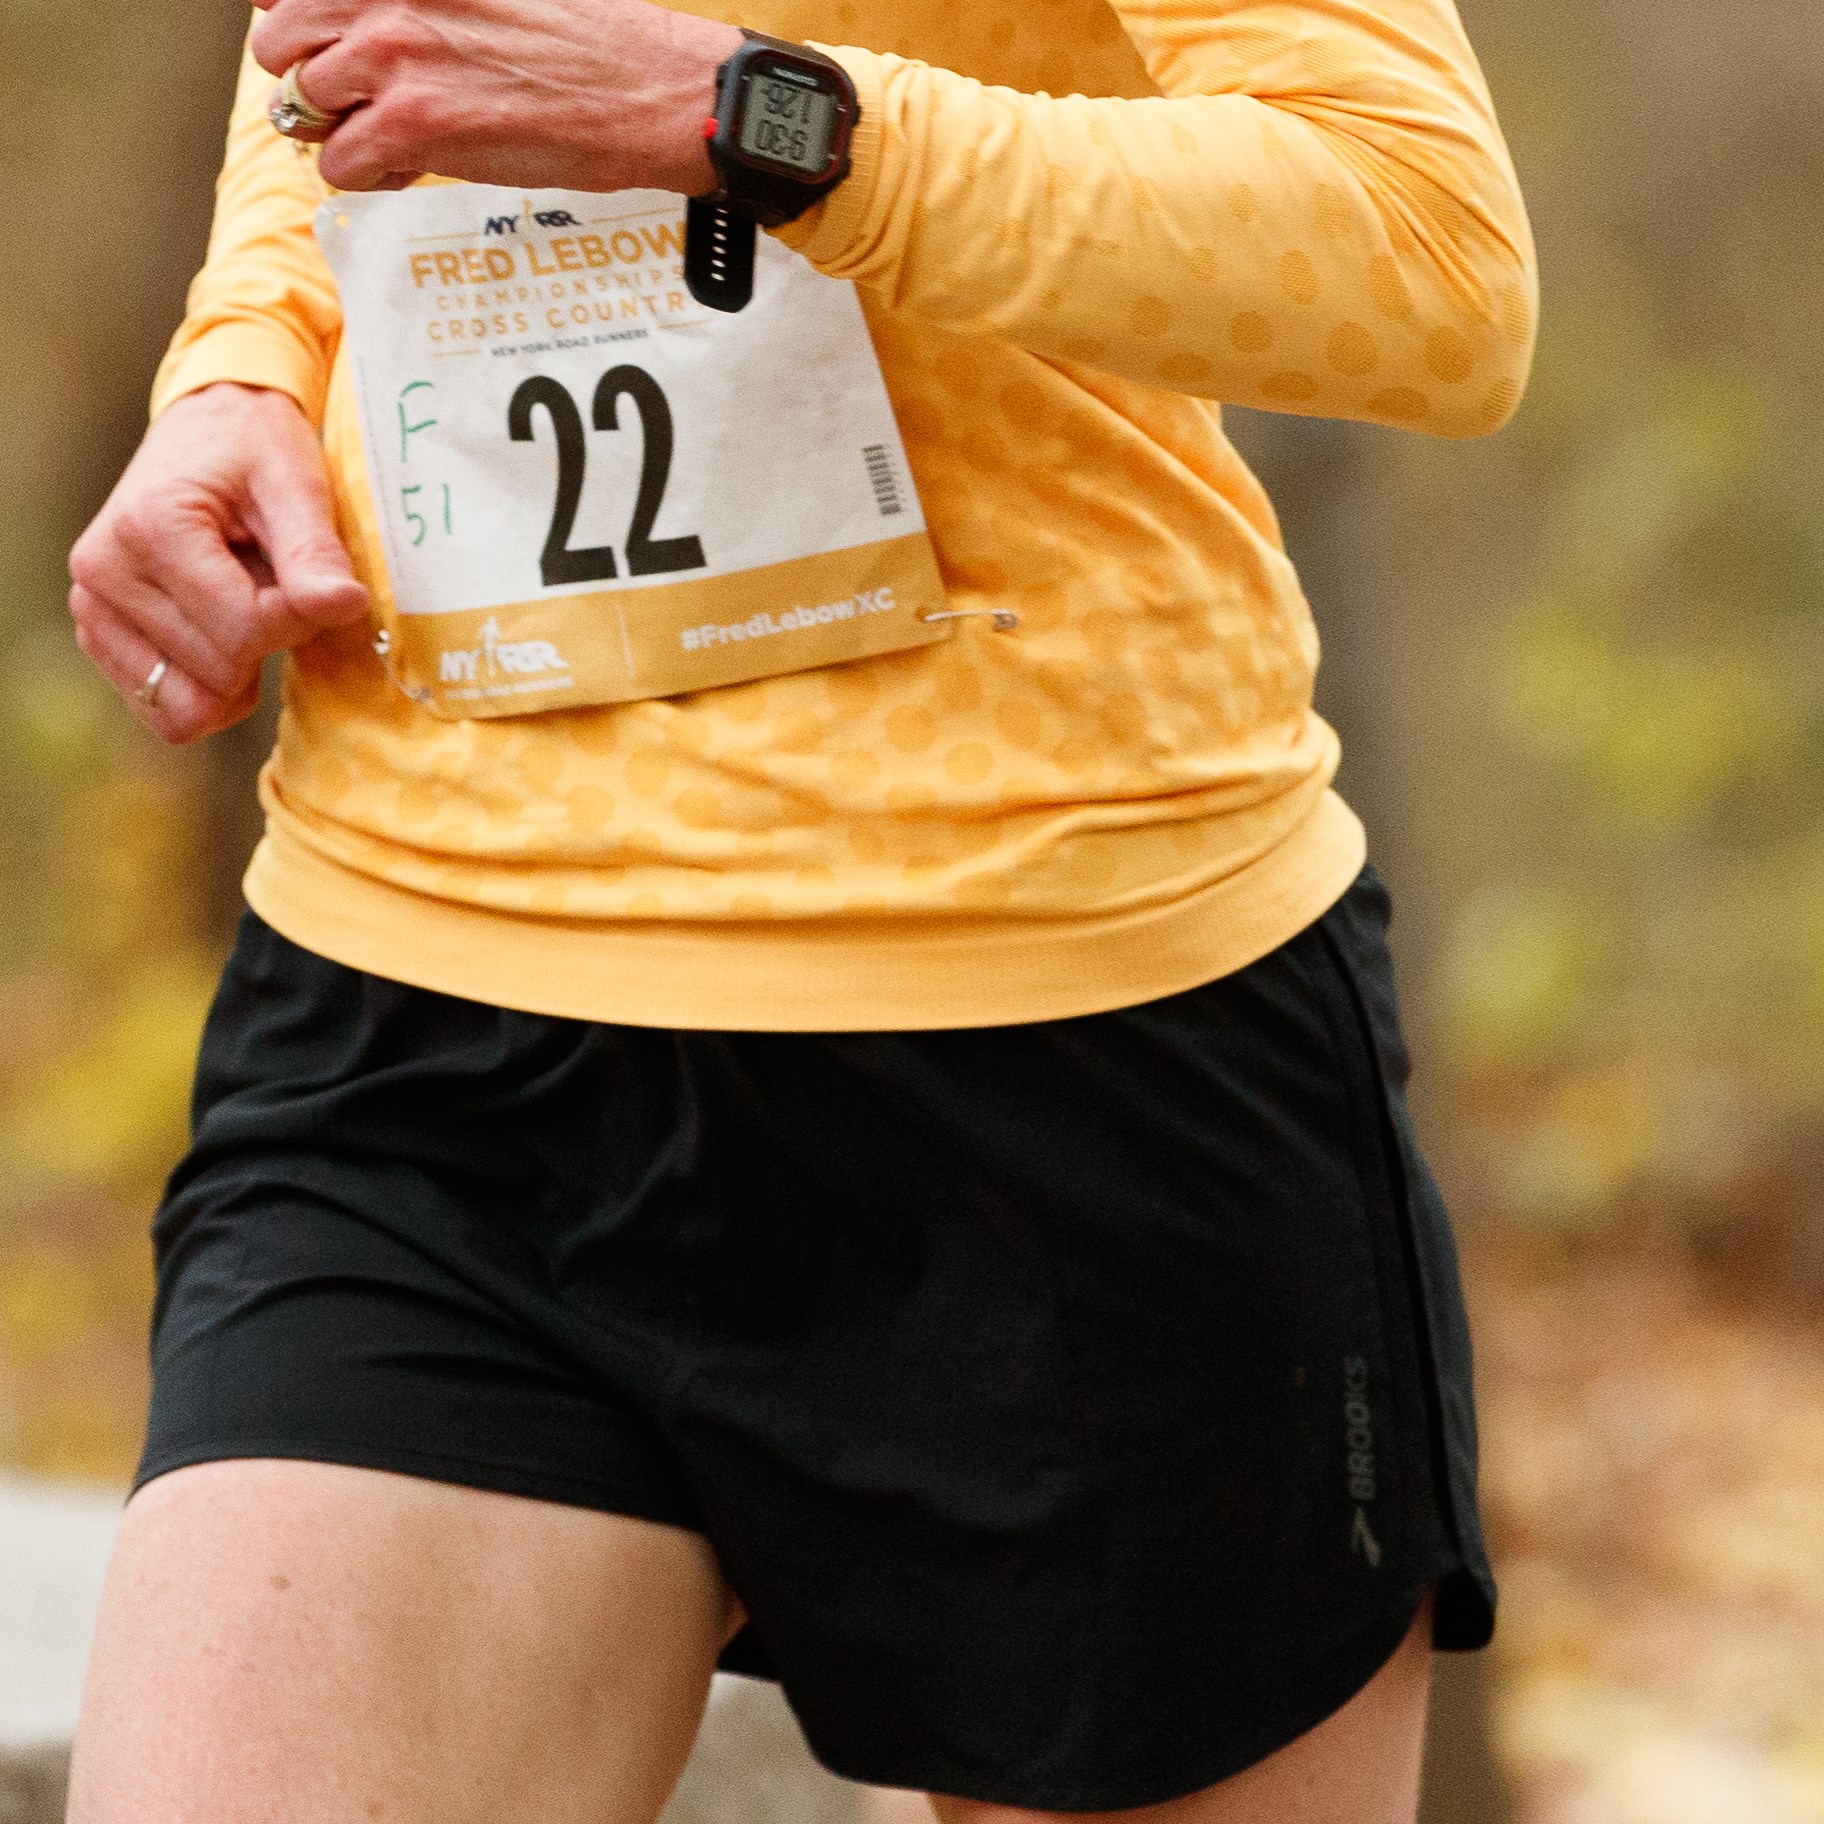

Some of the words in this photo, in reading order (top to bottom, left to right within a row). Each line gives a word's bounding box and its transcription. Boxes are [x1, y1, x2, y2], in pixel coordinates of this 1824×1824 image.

[408, 247, 516, 289] FRED
[524, 219, 686, 277] LEBOW
[428, 312, 528, 342] CROSS
[546, 290, 684, 329] COUNTR
[397, 380, 438, 463] F
[507, 363, 708, 588] 22
[400, 482, 453, 547] 51
[1342, 1355, 1377, 1501] BROOKS
